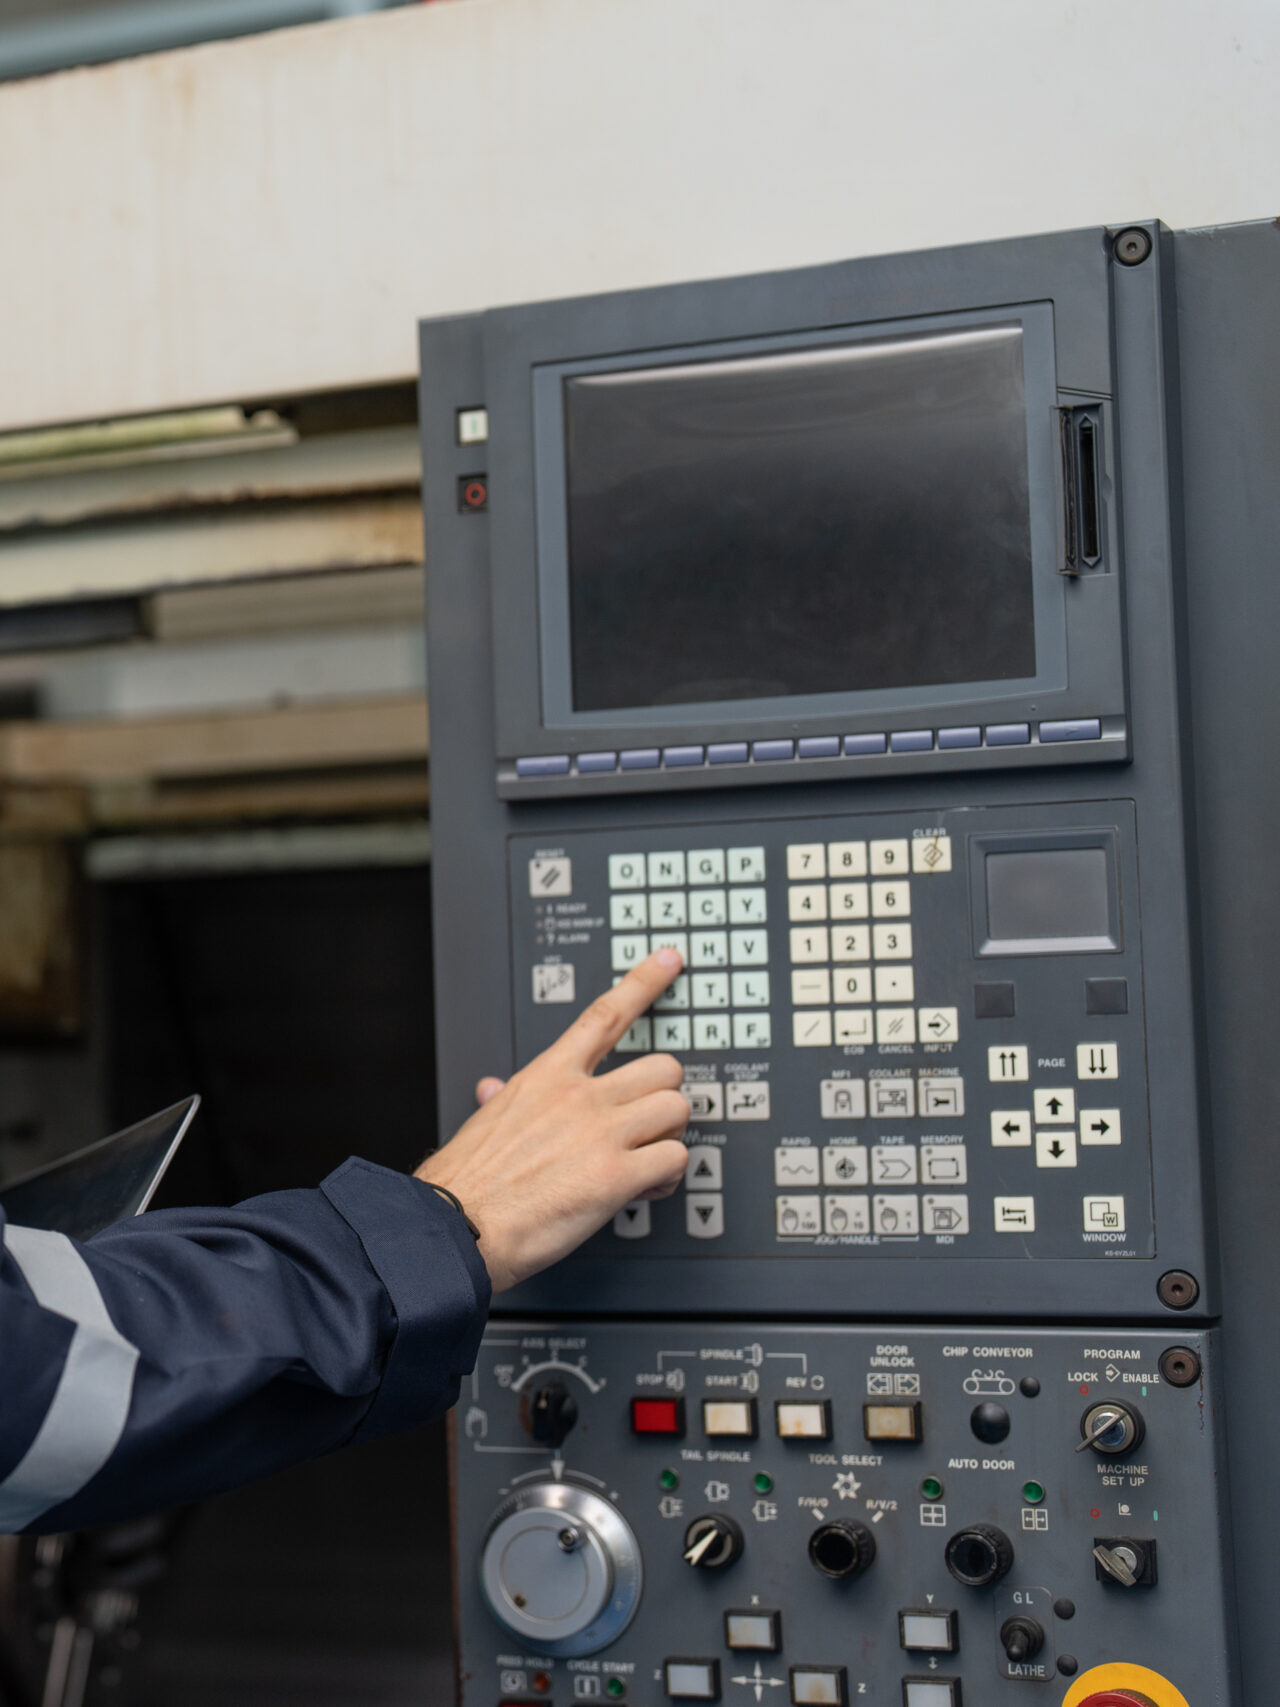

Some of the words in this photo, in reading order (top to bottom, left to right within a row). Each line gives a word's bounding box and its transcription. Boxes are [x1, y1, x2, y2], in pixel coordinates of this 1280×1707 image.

[913, 828, 946, 838] CLEAR
[801, 853, 811, 869] 7
[842, 852, 852, 867] 8
[884, 849, 894, 864] 9
[660, 862, 672, 876] N
[699, 858, 713, 874] G
[741, 857, 752, 872] P
[620, 863, 634, 879] O
[742, 898, 752, 912] Y
[802, 896, 811, 910] 4
[843, 894, 854, 909] 5
[885, 892, 896, 906] 6
[623, 904, 633, 919] X
[662, 902, 673, 917] Z
[701, 900, 713, 915] C
[743, 940, 754, 954] V
[805, 938, 811, 951] 1
[846, 936, 856, 951] 2
[887, 934, 897, 949] 3
[624, 946, 635, 961] U
[703, 942, 715, 957] H
[706, 983, 715, 998] T
[746, 982, 756, 997] L
[847, 978, 857, 993] 0
[666, 1025, 678, 1041] K
[706, 1024, 718, 1039] R
[747, 1023, 756, 1038] F
[844, 1046, 865, 1055] EOB
[878, 1045, 915, 1054] CANCEL
[923, 1043, 953, 1053] INPUT
[724, 1062, 770, 1073] COOLANT
[1038, 1058, 1066, 1068] PAGE
[869, 1068, 912, 1078] COOLANT
[919, 1067, 960, 1077] MACHINE
[781, 1137, 811, 1146] RAPID
[829, 1136, 858, 1145] HOME
[880, 1136, 905, 1144] TAPE
[920, 1135, 964, 1144] MEMORY
[935, 1236, 955, 1244] MDI
[1082, 1233, 1127, 1243] WINDOW
[700, 1349, 744, 1360] SPINDLE
[876, 1345, 908, 1355] DOOR
[942, 1346, 969, 1357] CHIP
[972, 1347, 1033, 1358] CONVEYOR
[1084, 1349, 1141, 1359] PROGRAM
[870, 1357, 915, 1367] UNLOCK
[636, 1374, 663, 1385] STOP
[705, 1375, 738, 1386] START
[786, 1377, 807, 1388] REV
[1068, 1372, 1099, 1382] LOCK
[1122, 1373, 1159, 1383] ENABLE
[681, 1450, 704, 1460] TAIL
[706, 1451, 751, 1462] SPINDLE
[808, 1454, 838, 1464] TOOL
[841, 1455, 883, 1466] SELECT
[948, 1459, 979, 1469] AUTO
[982, 1460, 1015, 1470] DOOR
[1097, 1464, 1149, 1475] MACHINE
[1102, 1476, 1124, 1486] SET
[1130, 1477, 1145, 1486] UP
[926, 1594, 934, 1604] Y
[603, 1662, 635, 1674] START
[1007, 1663, 1046, 1677] LATHE
[858, 1683, 867, 1694] Z
